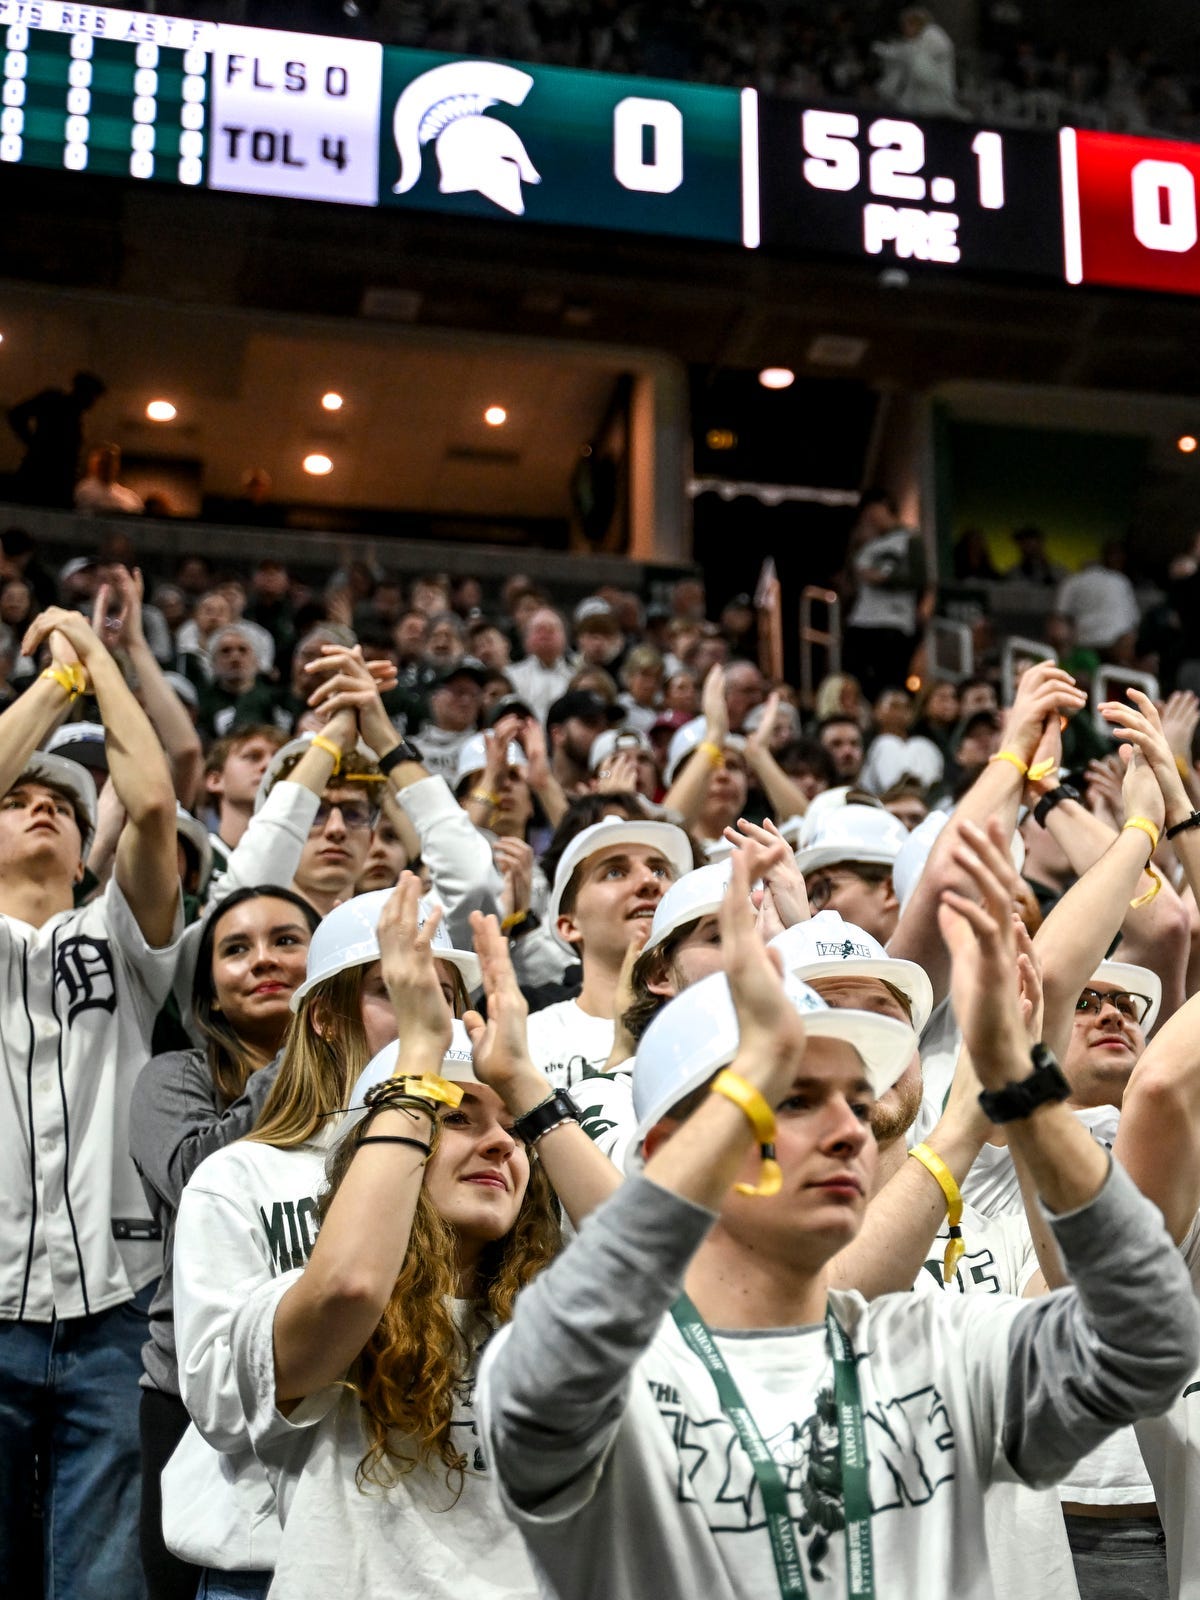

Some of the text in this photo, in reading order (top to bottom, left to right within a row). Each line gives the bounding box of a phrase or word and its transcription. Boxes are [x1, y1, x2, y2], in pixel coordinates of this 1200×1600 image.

[227, 54, 348, 97] FLS 0
[222, 127, 347, 171] TOL 4
[614, 97, 683, 193] 0
[802, 109, 1004, 210] 52.1
[1131, 159, 1198, 253] 0
[863, 203, 961, 263] PRE
[816, 939, 872, 959] IZZNE
[545, 1062, 564, 1075] the
[689, 1322, 714, 1354] AXIOS
[843, 1427, 858, 1467] AXIOS
[778, 1515, 796, 1562] AXIOS
